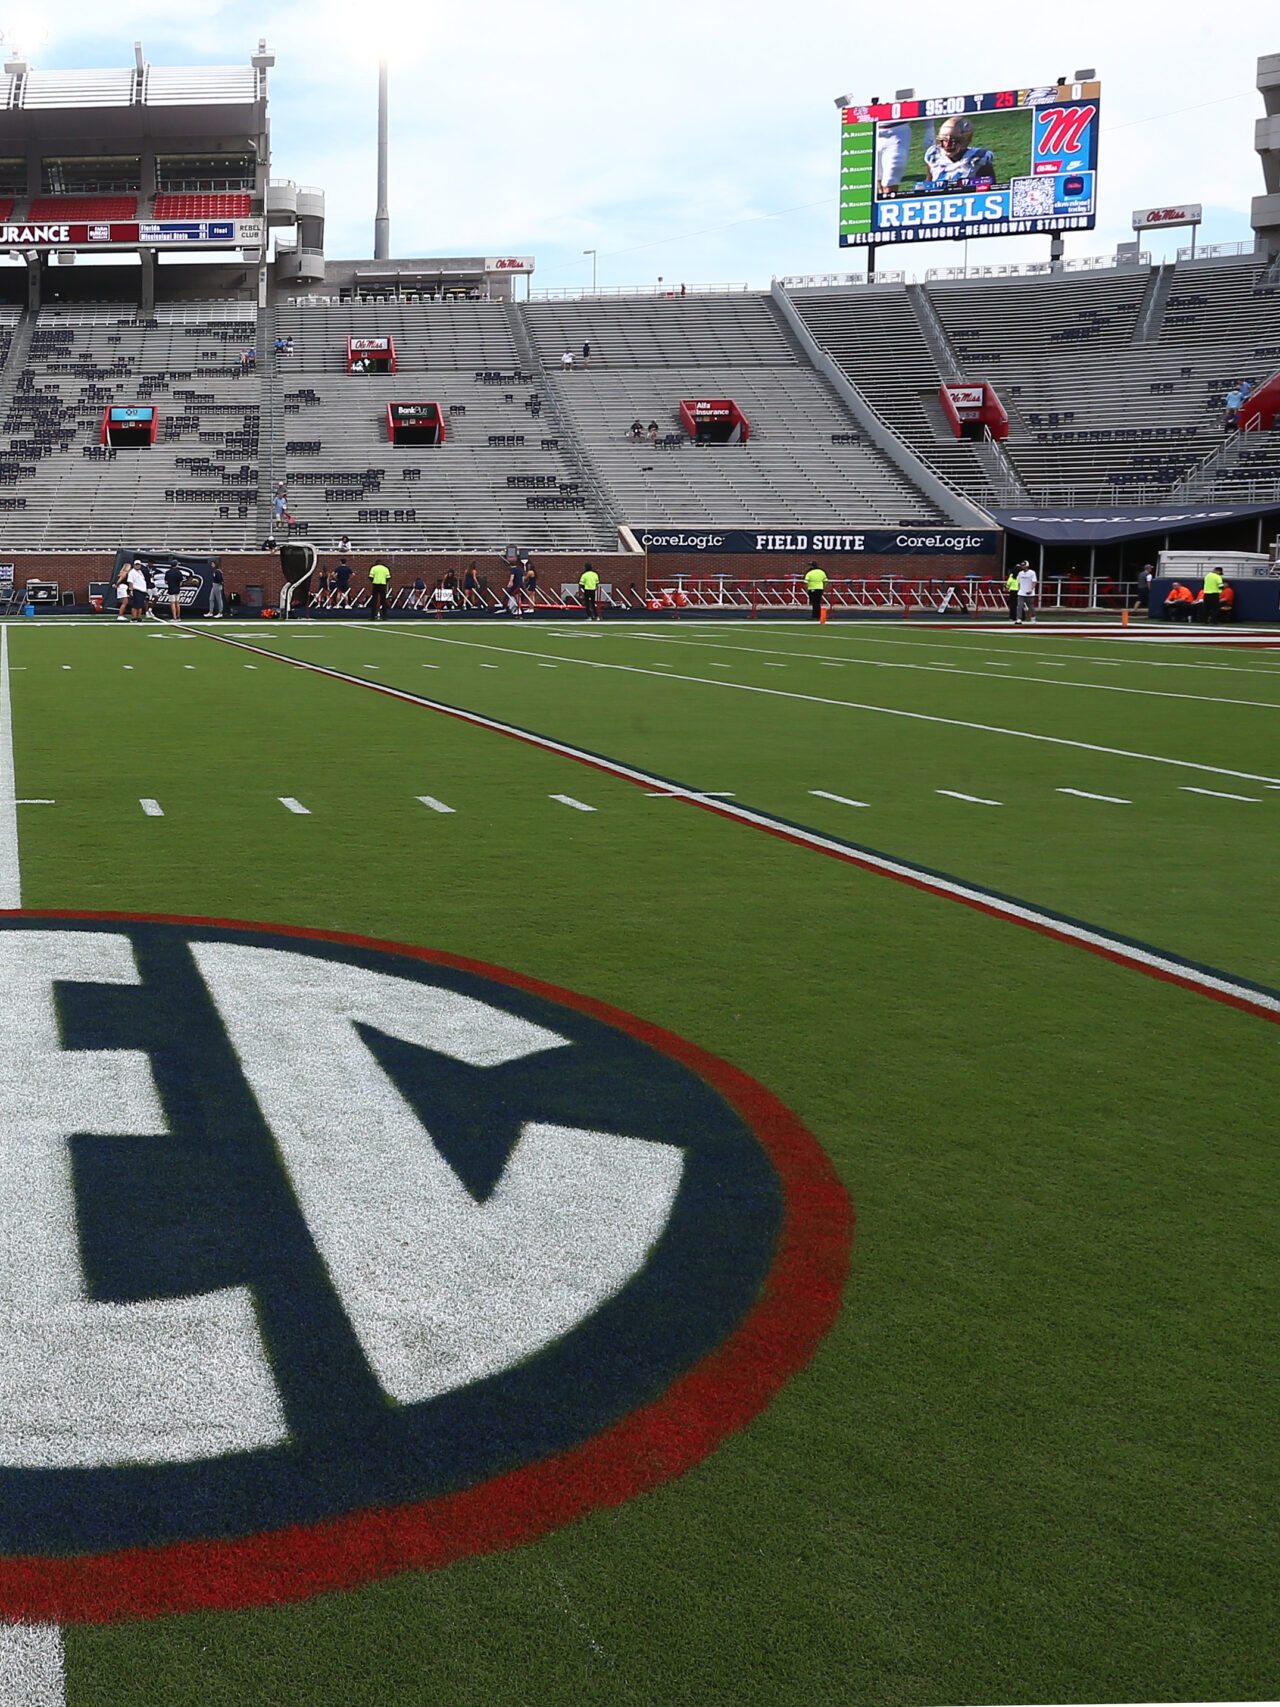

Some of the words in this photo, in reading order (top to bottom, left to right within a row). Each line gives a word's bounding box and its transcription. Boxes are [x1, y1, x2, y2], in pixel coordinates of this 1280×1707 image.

[925, 97, 965, 116] 95:00
[995, 91, 1015, 108] 25
[891, 103, 901, 119] 0
[880, 196, 1003, 228] REBELS
[847, 230, 897, 244] WELCOME
[901, 229, 914, 240] TO
[918, 221, 1032, 239] VAUGHT-HEMINGWAY
[1036, 216, 1088, 231] STADIUM
[642, 534, 723, 549] CoreLogic
[756, 535, 808, 550] FIELD
[812, 535, 865, 550] SUITE
[896, 535, 982, 550] CoreLogic
